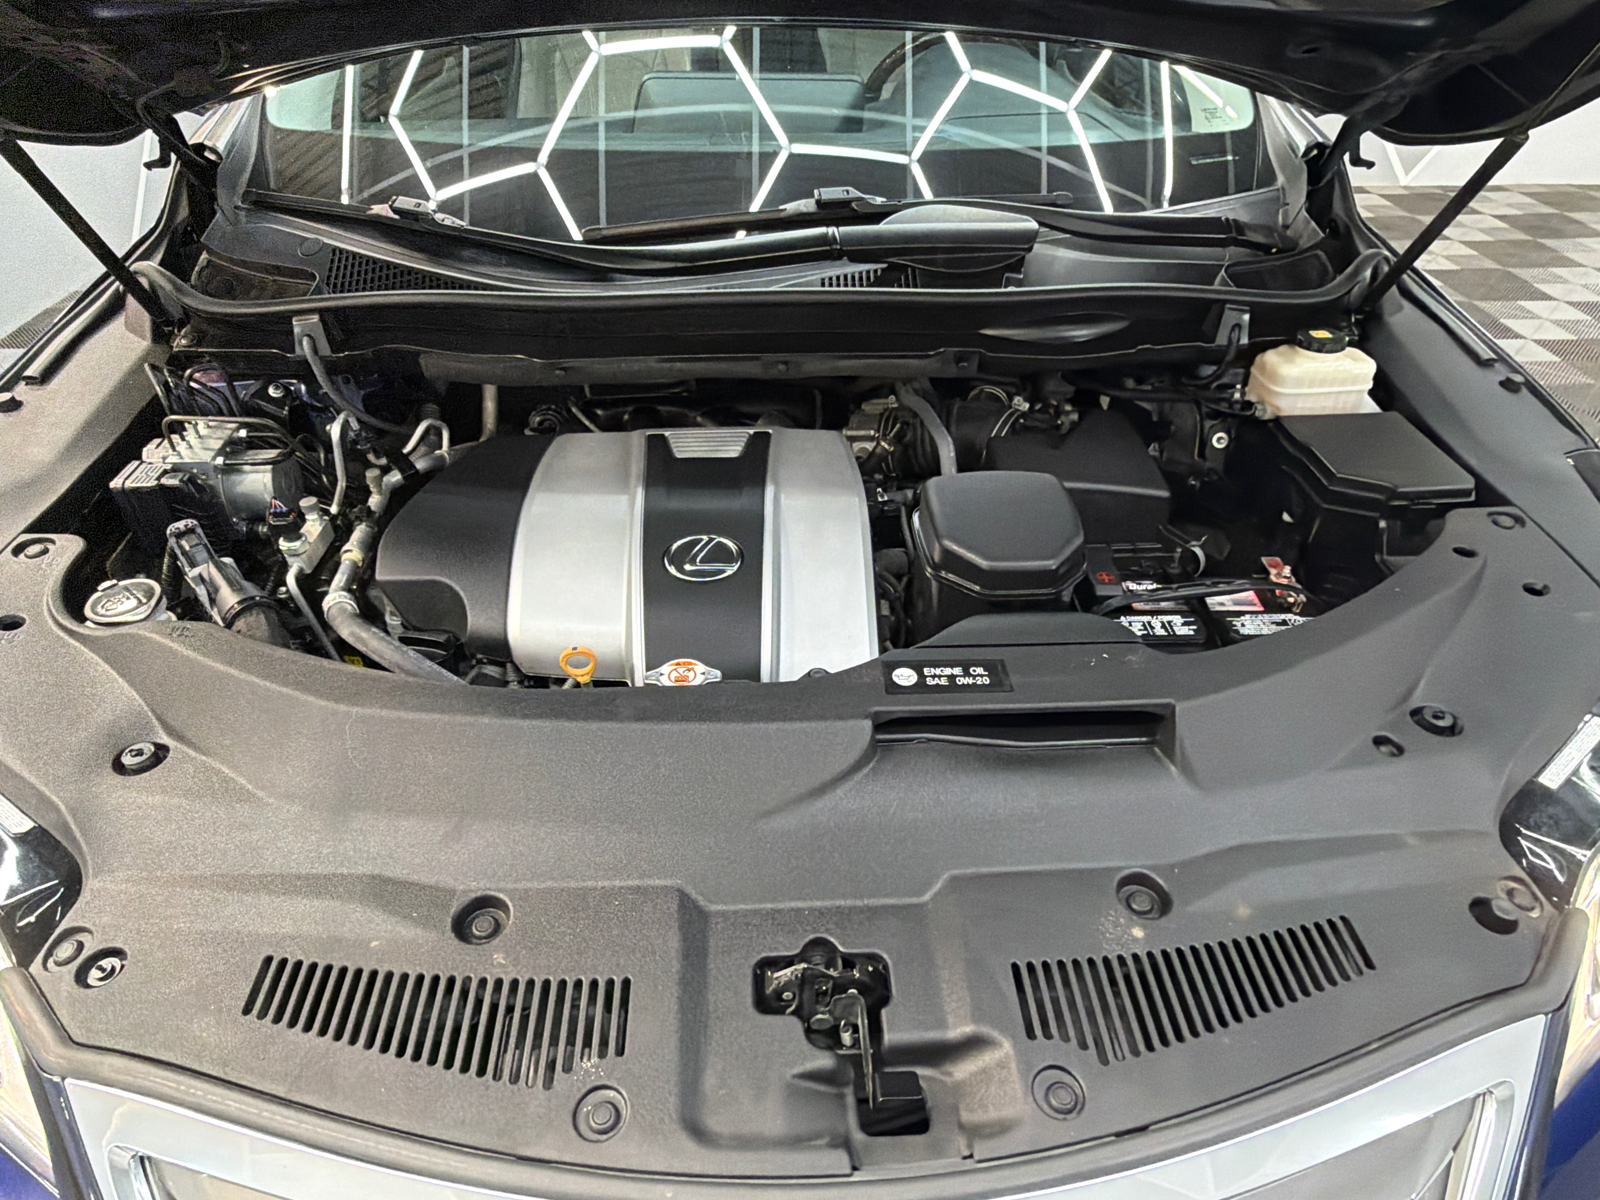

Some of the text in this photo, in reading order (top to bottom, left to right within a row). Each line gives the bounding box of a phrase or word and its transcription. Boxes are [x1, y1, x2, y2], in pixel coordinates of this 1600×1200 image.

[1128, 582, 1162, 591] Dural
[923, 667, 989, 676] ENGINE OIL
[926, 676, 990, 685] SAE 0W-20
